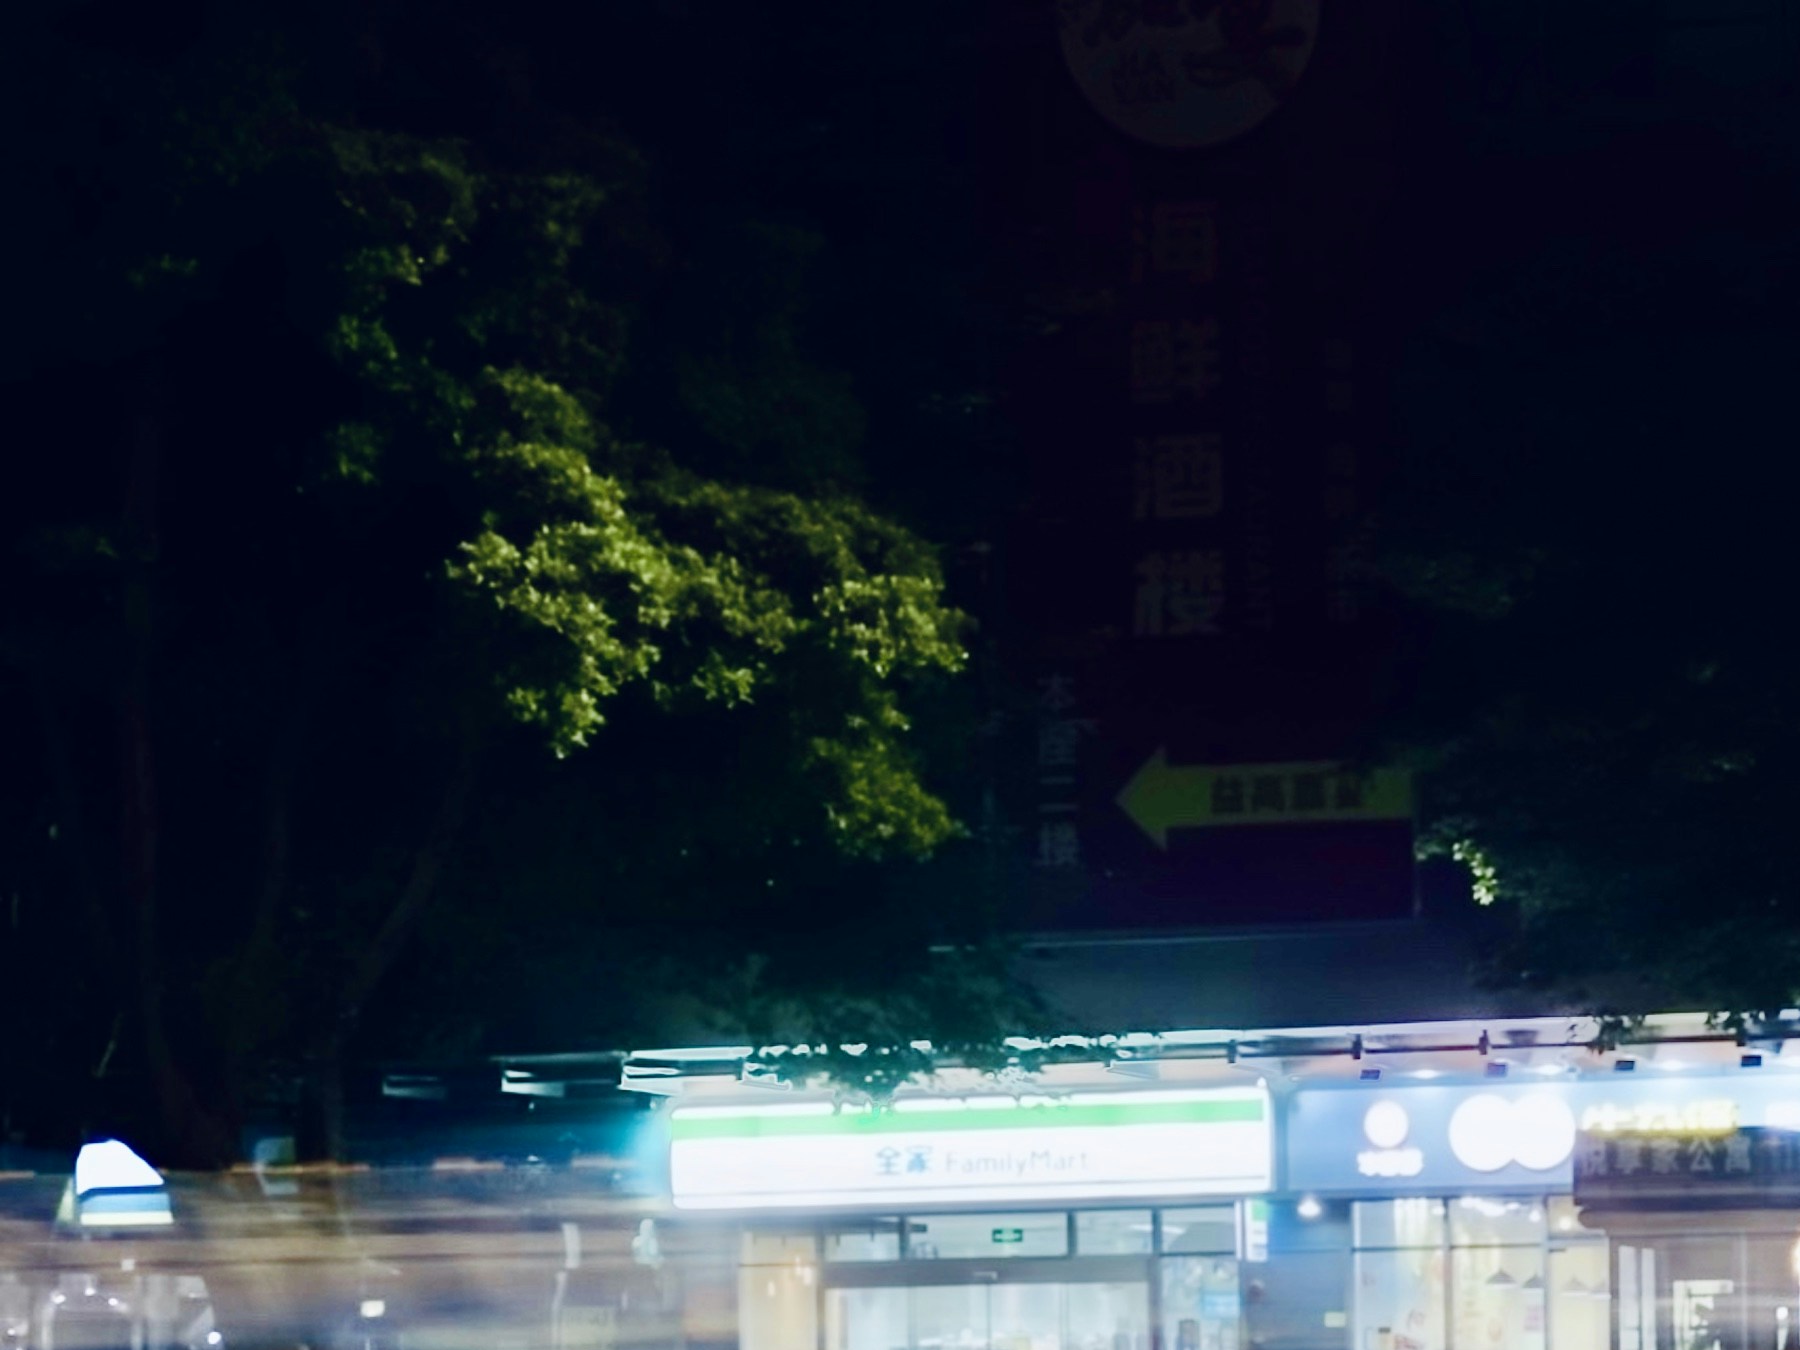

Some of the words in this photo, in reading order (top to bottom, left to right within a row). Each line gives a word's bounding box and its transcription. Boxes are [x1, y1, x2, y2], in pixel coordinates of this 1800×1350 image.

[1129, 199, 1225, 638] 海鲜酒楼
[875, 1145, 933, 1177] 全家
[945, 1148, 1089, 1178] FamilyMart
